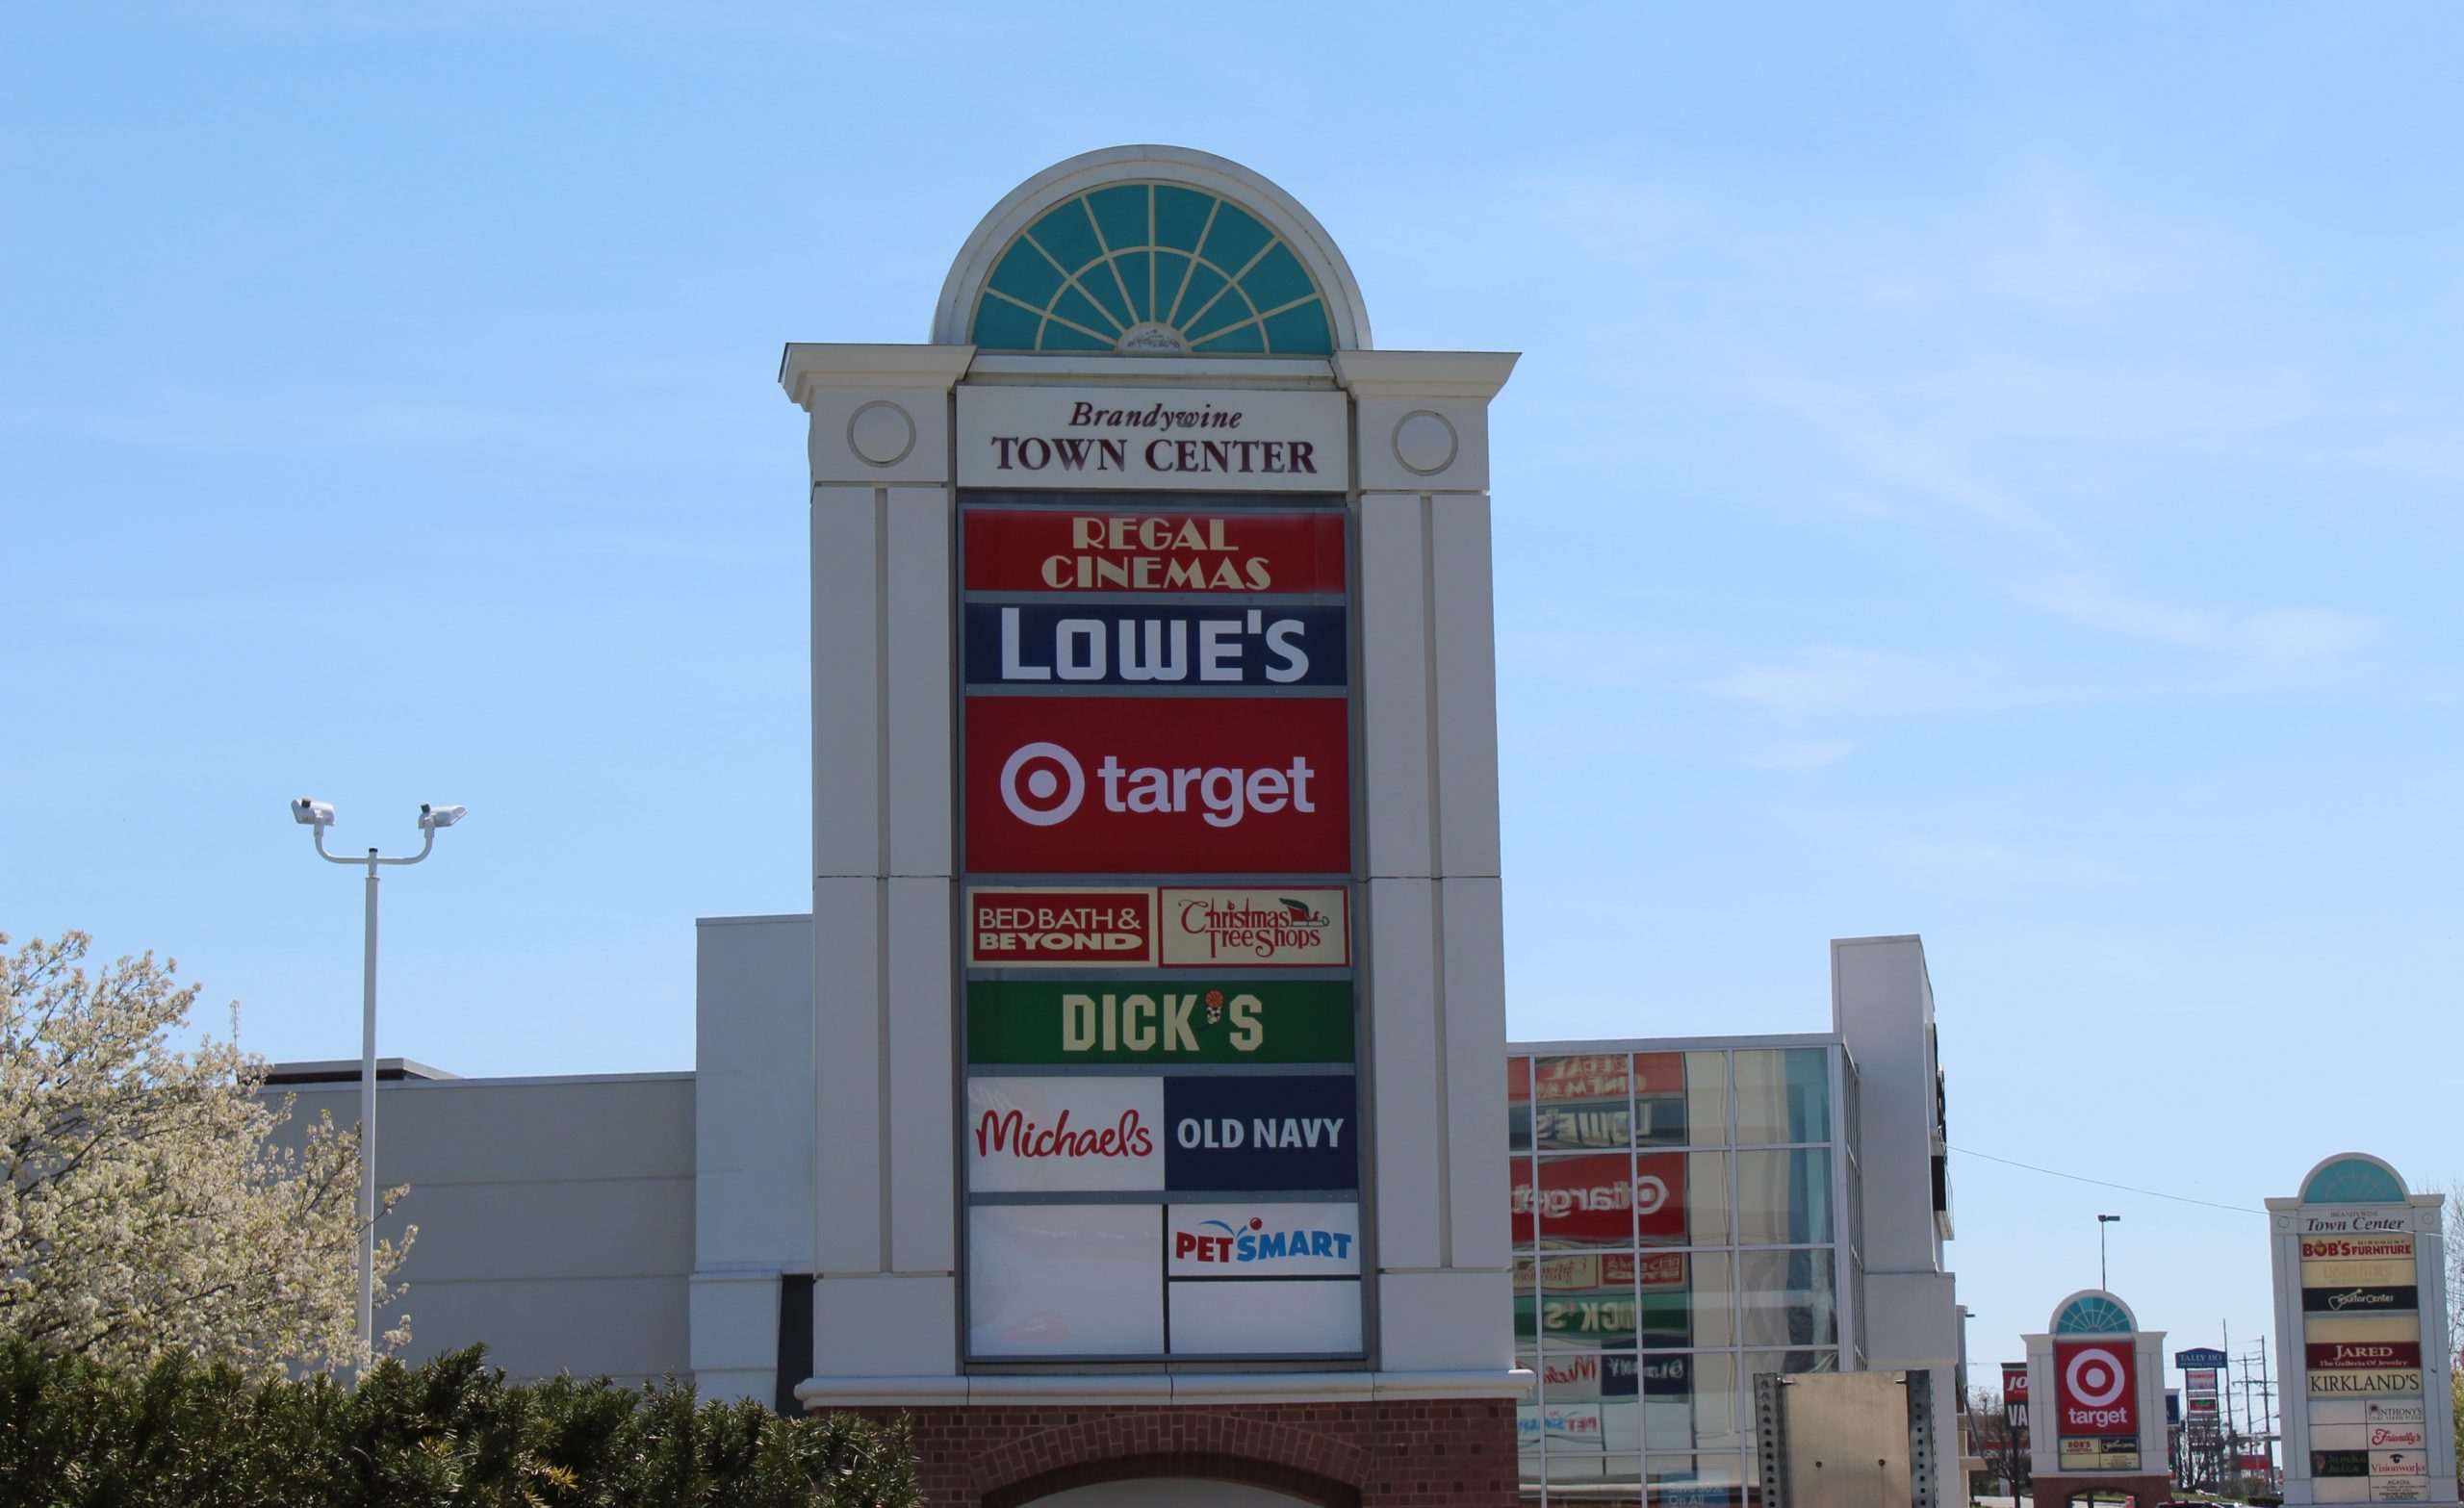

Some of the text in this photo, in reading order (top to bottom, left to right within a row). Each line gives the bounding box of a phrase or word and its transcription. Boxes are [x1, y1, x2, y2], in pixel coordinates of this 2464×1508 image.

[1068, 401, 1243, 432] Brandywine
[991, 436, 1318, 473] TOWN CENTER
[1072, 517, 1240, 551] REGAL
[1040, 555, 1271, 591] CINEMAS
[1001, 607, 1310, 682] LOWE'S
[1097, 755, 1316, 828] target
[979, 907, 1142, 930] BED BATH &
[1178, 897, 1292, 934] Christmas
[979, 933, 1143, 951] BEYOND
[1063, 990, 1264, 1052] DICK'S
[975, 1109, 1153, 1158] Michaels
[1177, 1118, 1345, 1149] OLD NAVY
[2306, 1216, 2404, 1232] Town Center
[2302, 1240, 2350, 1257] BOB'S
[2351, 1244, 2411, 1256] FURNITURE
[2333, 1345, 2393, 1360] JARED
[2310, 1373, 2419, 1393] KIRKLAND'S
[2067, 1407, 2127, 1428] target
[2371, 1462, 2426, 1472] Visionworks
